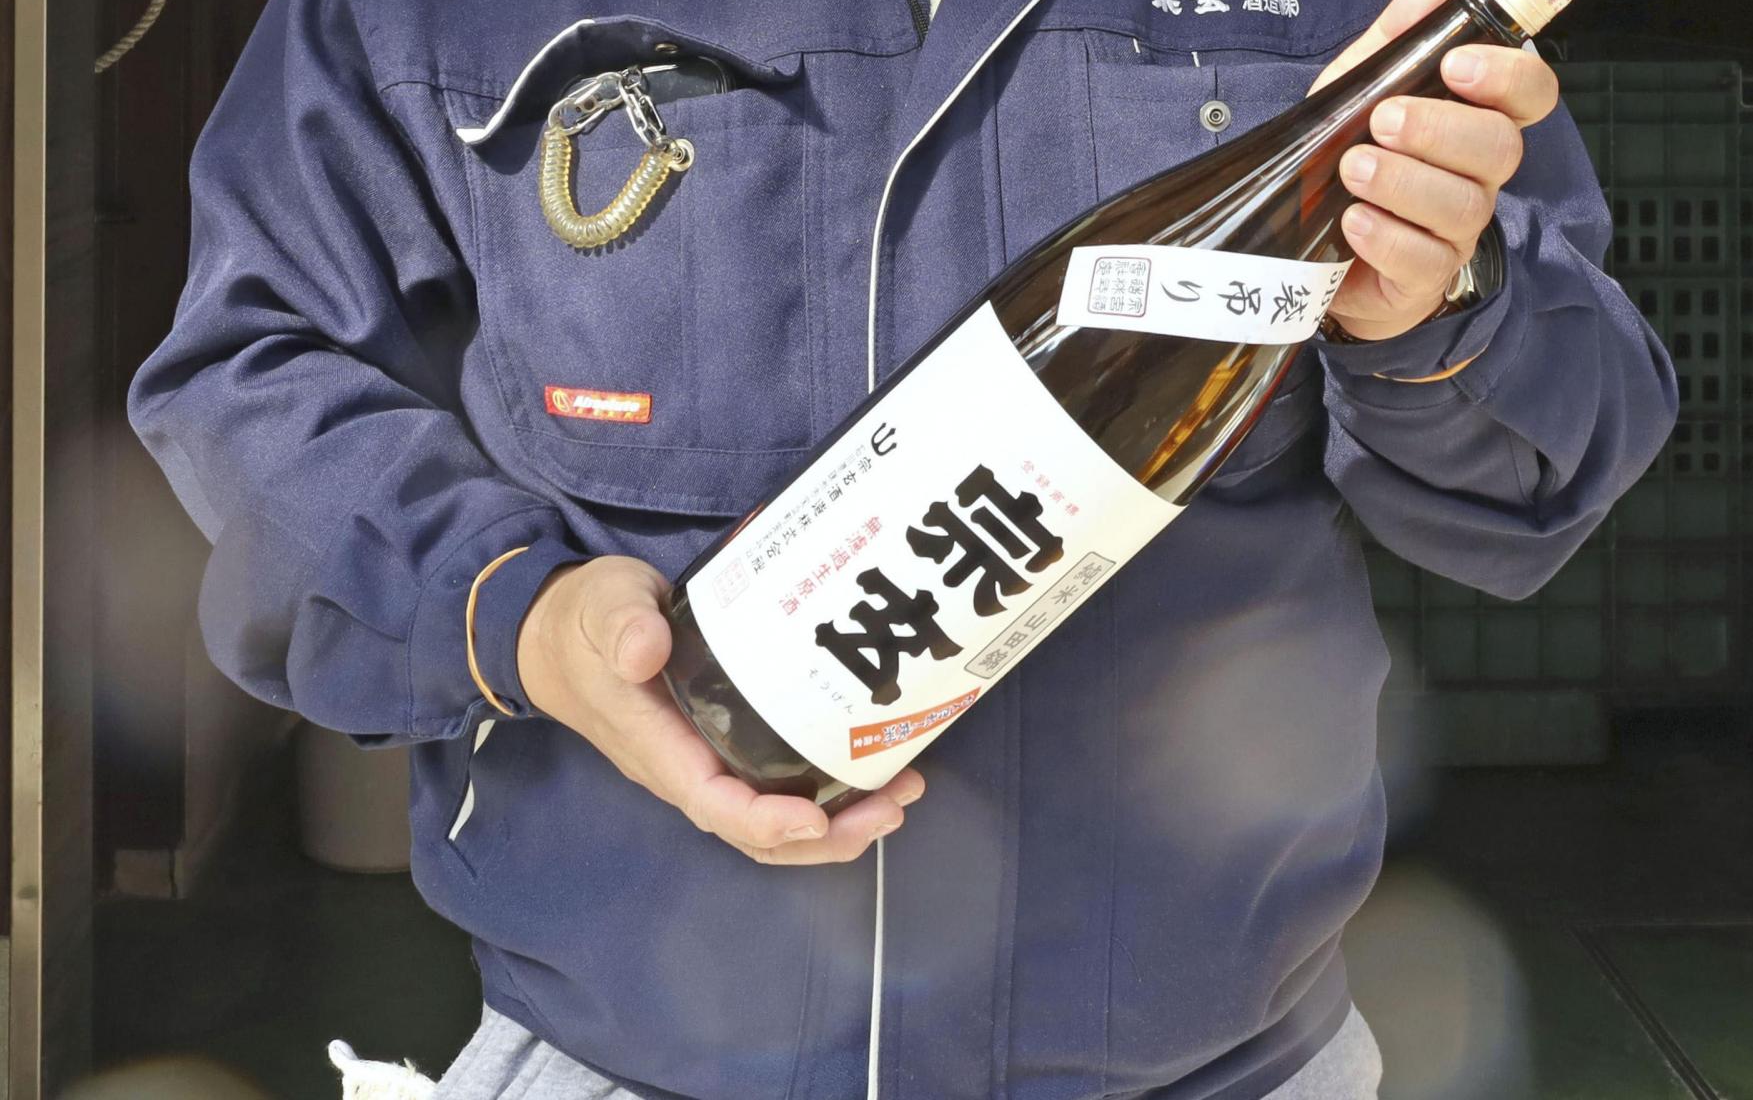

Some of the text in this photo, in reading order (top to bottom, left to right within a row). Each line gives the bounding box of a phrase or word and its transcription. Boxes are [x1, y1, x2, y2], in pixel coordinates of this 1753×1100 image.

[1161, 280, 1311, 326] 袋吊り
[778, 515, 885, 617] 無濾過生原酒
[814, 464, 1064, 706] 宗玄
